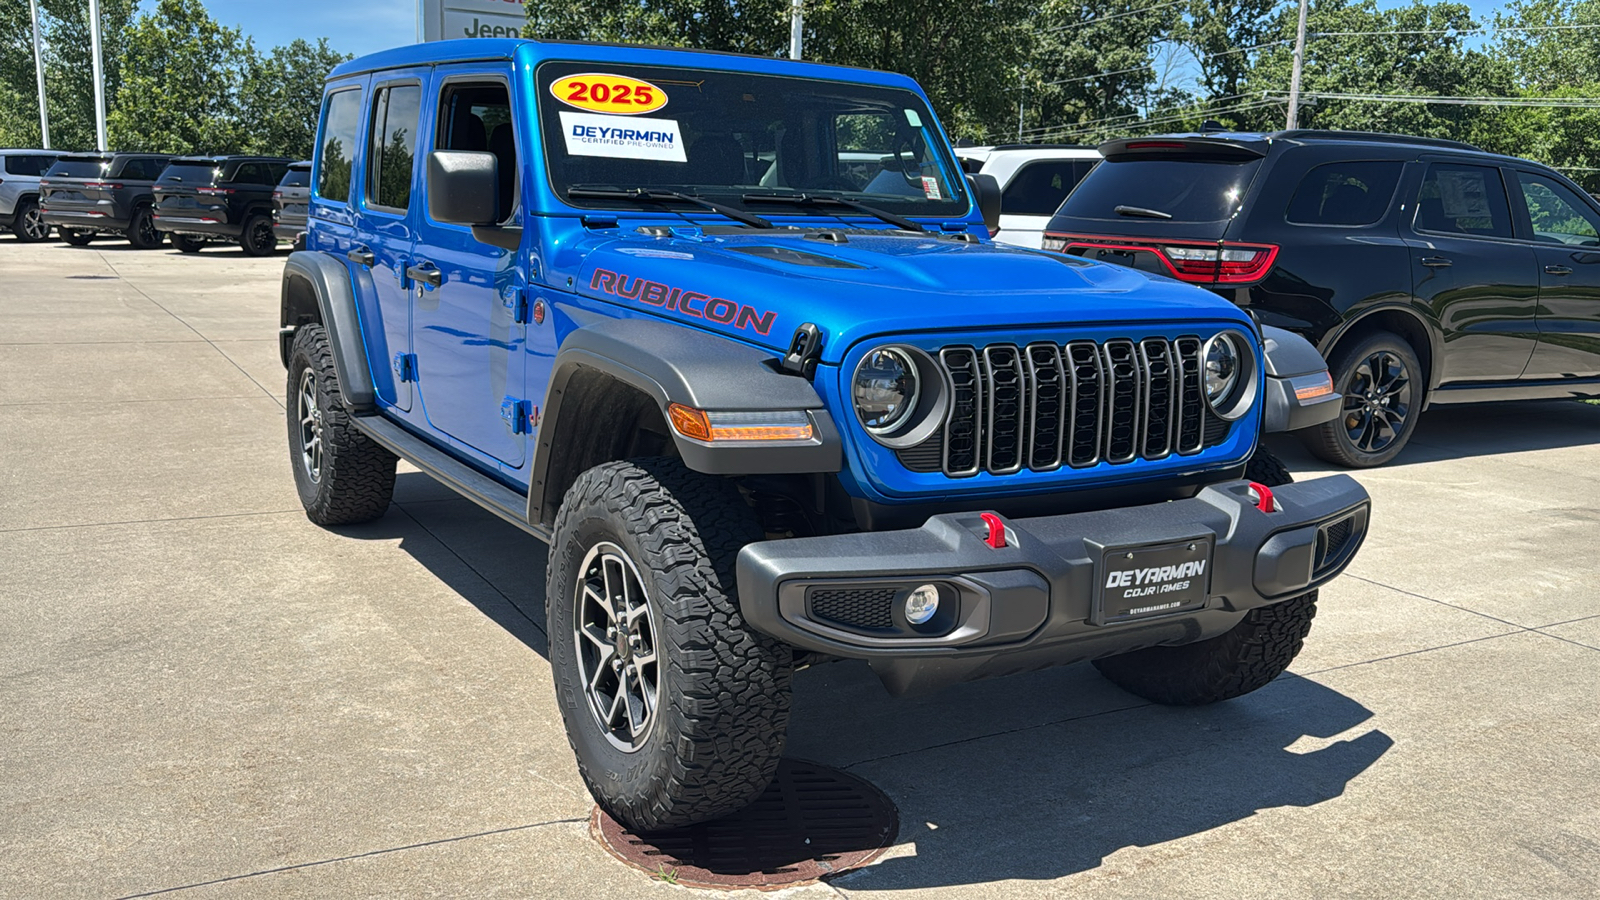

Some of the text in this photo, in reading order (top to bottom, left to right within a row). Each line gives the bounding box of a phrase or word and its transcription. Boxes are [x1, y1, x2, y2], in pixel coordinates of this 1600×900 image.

[567, 82, 653, 105] 2025
[572, 125, 674, 144] DEYARMAN
[581, 137, 674, 149] CERTIFIED PRE-OWNED
[590, 267, 778, 336] RUBICON
[1105, 559, 1206, 589] DEYARMAN
[1123, 580, 1190, 598] CDJR AMES
[1129, 601, 1181, 615] DEYARMANAMES.COM
